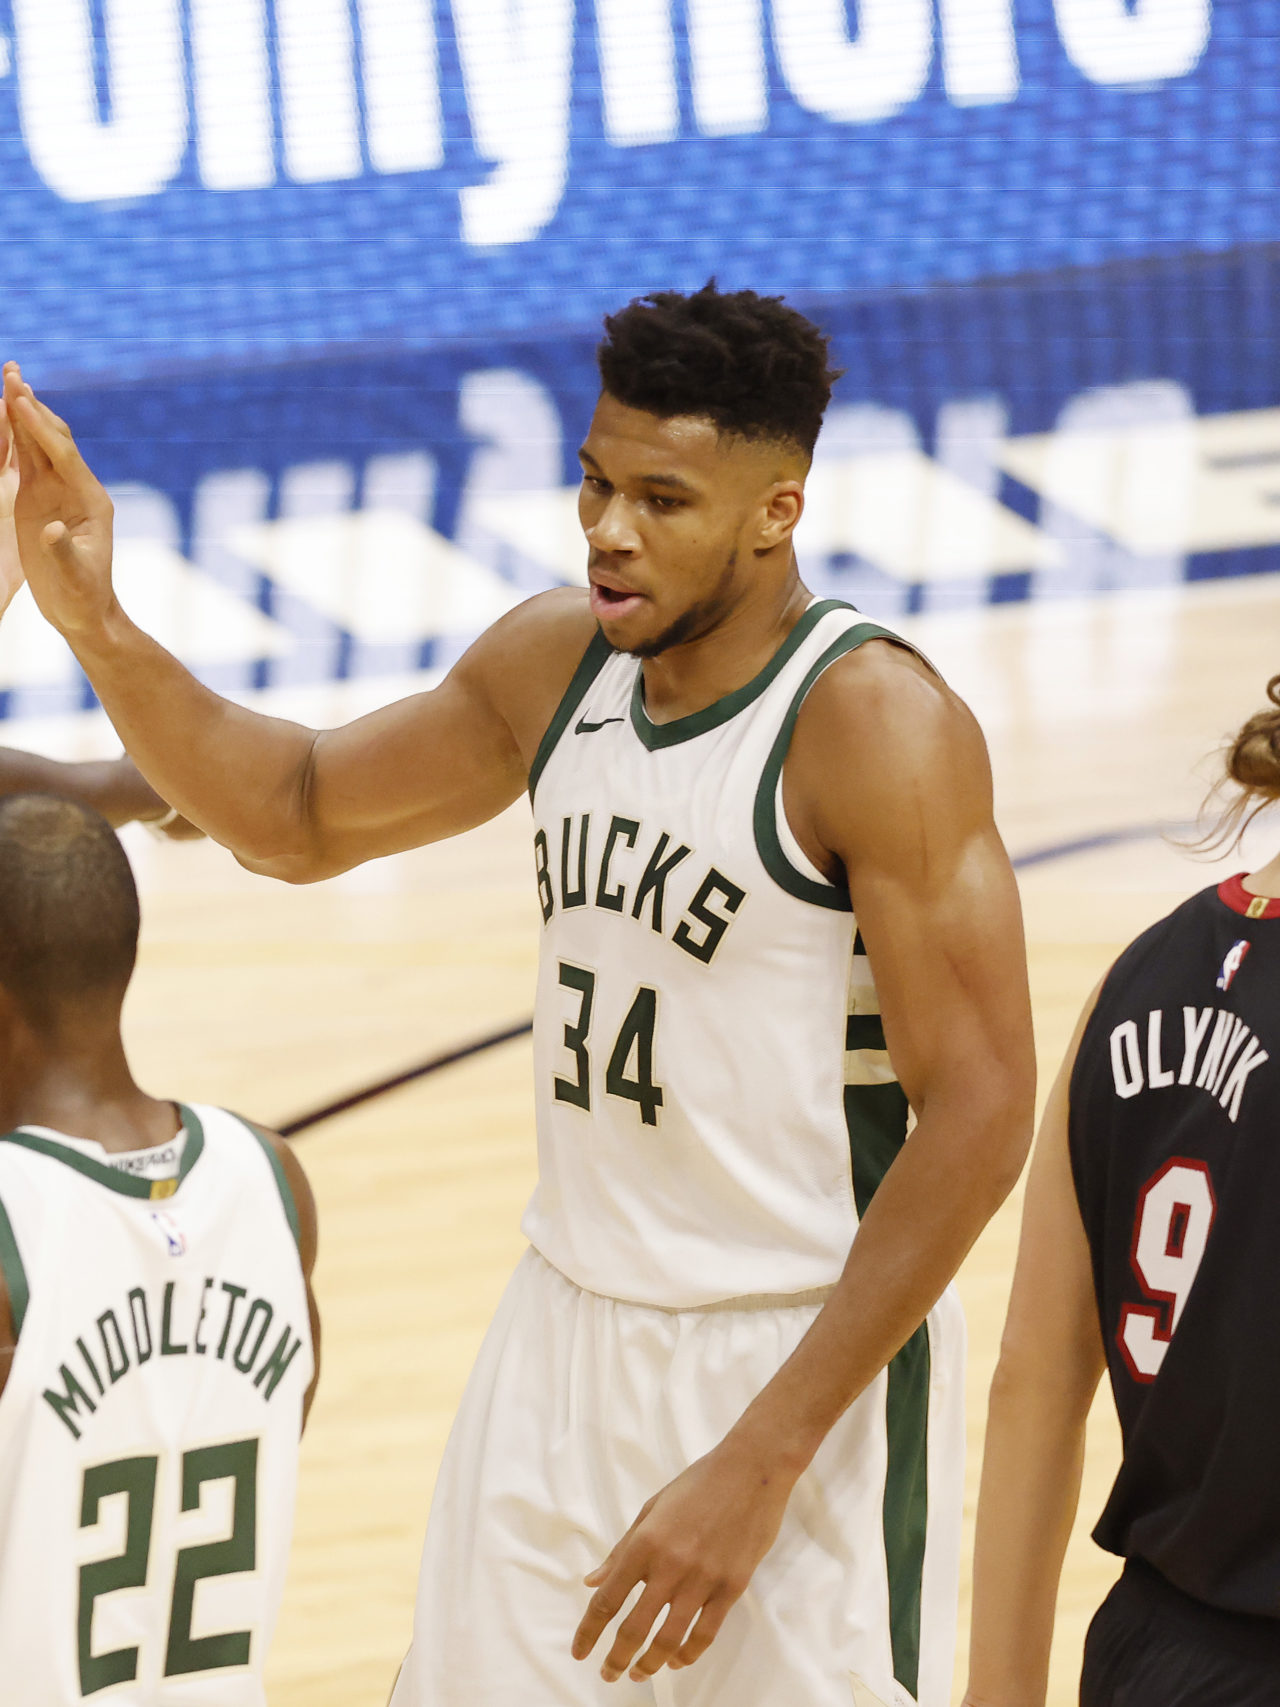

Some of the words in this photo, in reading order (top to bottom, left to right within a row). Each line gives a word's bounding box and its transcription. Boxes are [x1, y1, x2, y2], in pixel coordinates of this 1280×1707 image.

[533, 812, 749, 967] BUCKS
[553, 958, 665, 1128] 34
[1116, 1155, 1218, 1384] 9
[75, 1434, 261, 1699] 22
